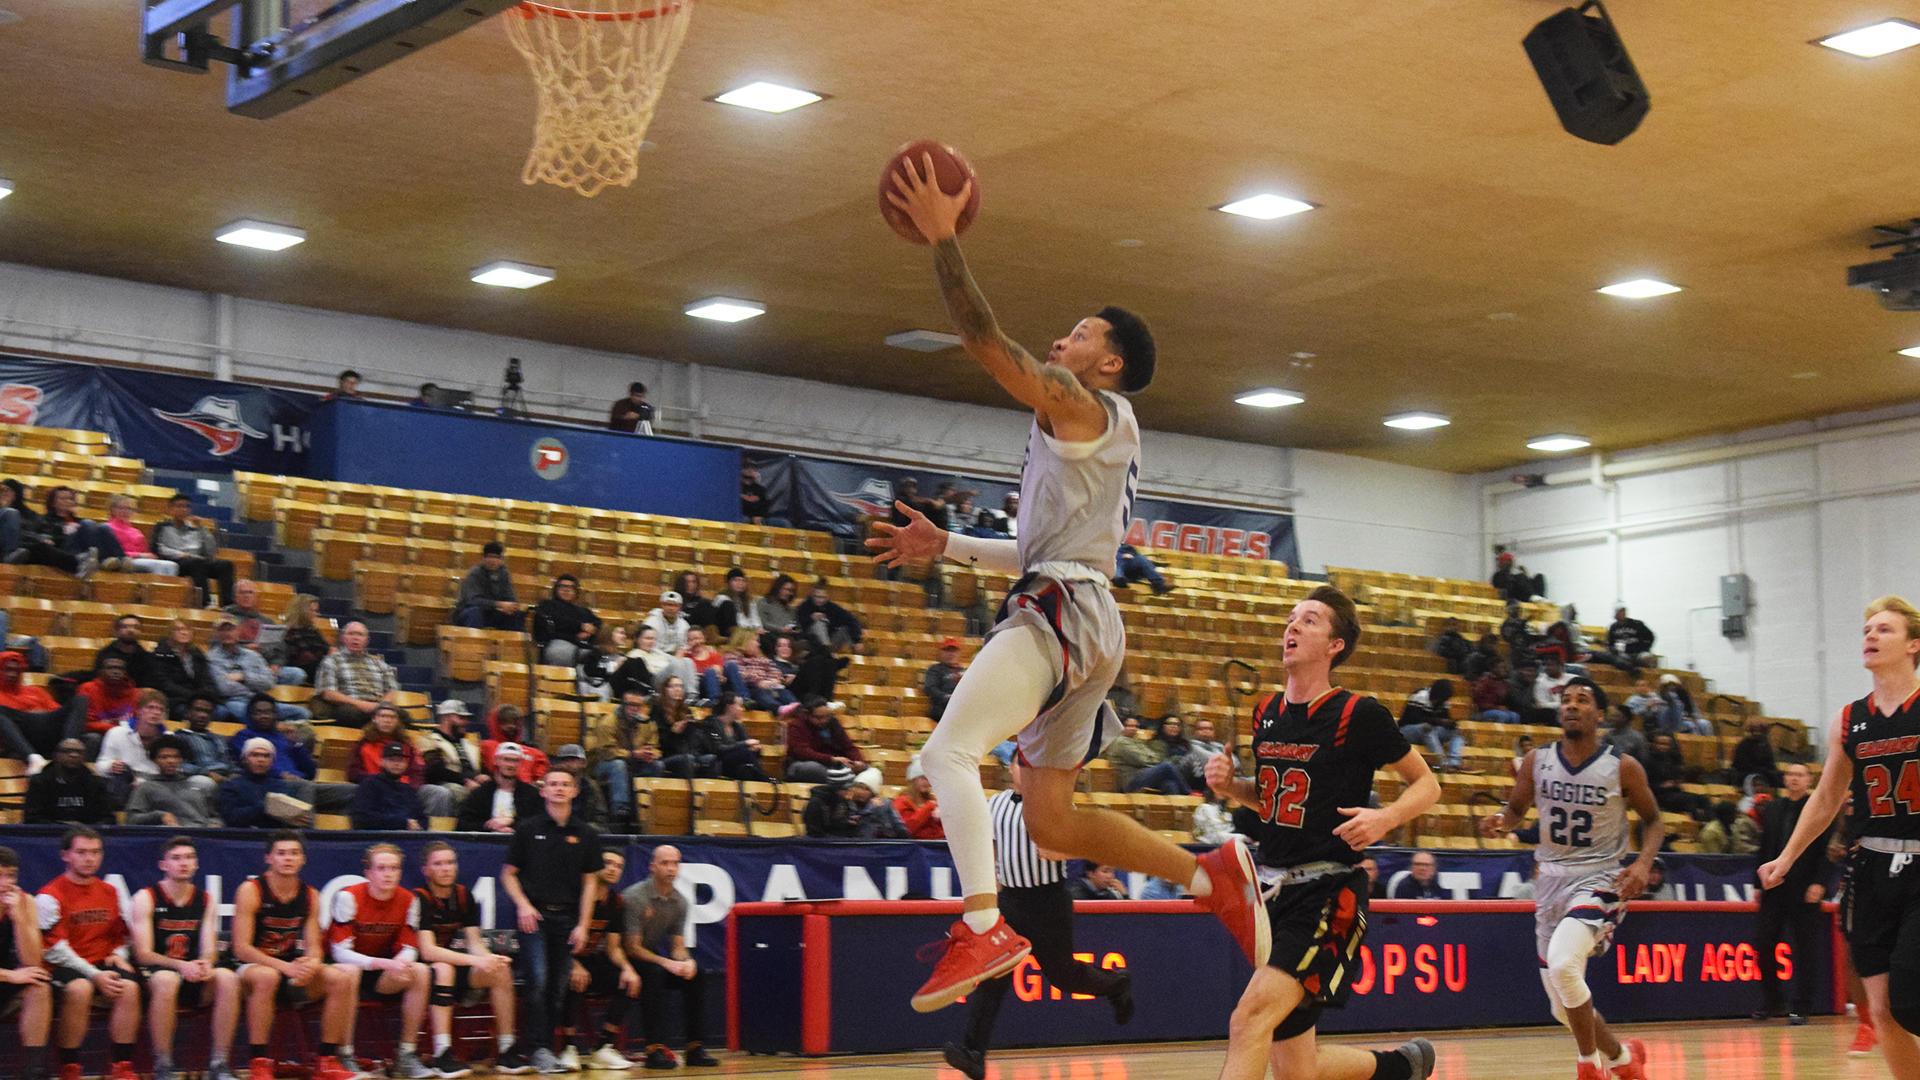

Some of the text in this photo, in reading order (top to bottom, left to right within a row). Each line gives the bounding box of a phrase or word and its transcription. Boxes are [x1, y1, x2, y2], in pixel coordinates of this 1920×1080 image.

[1122, 517, 1272, 561] AGGIES
[1258, 765, 1311, 829] 32
[1540, 779, 1608, 806] AGGIES
[1862, 759, 1920, 818] 24
[1550, 806, 1593, 847] 22
[1616, 942, 1687, 984] LADY
